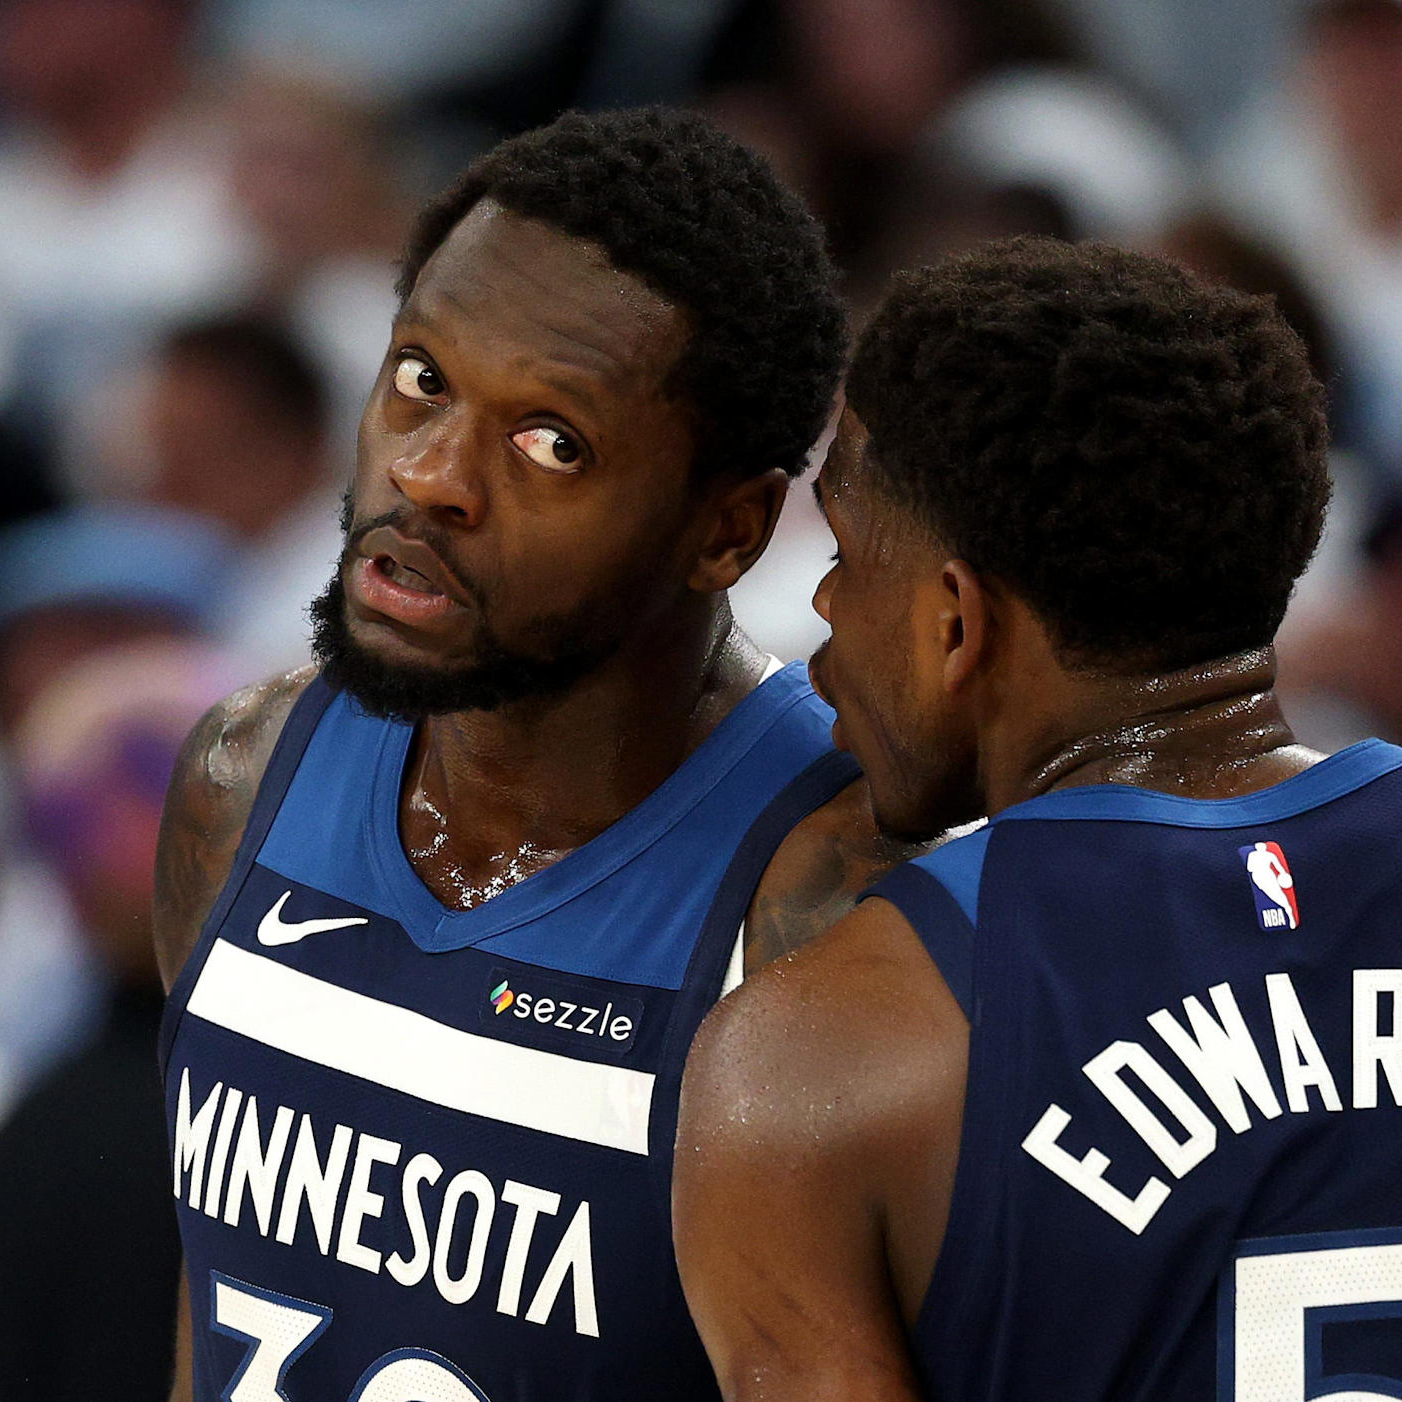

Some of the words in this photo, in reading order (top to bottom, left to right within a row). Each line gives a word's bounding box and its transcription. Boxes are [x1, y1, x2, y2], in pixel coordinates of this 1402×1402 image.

[1262, 908, 1286, 928] NBA
[513, 992, 633, 1041] sezzle
[173, 1066, 600, 1338] MINNESOTA
